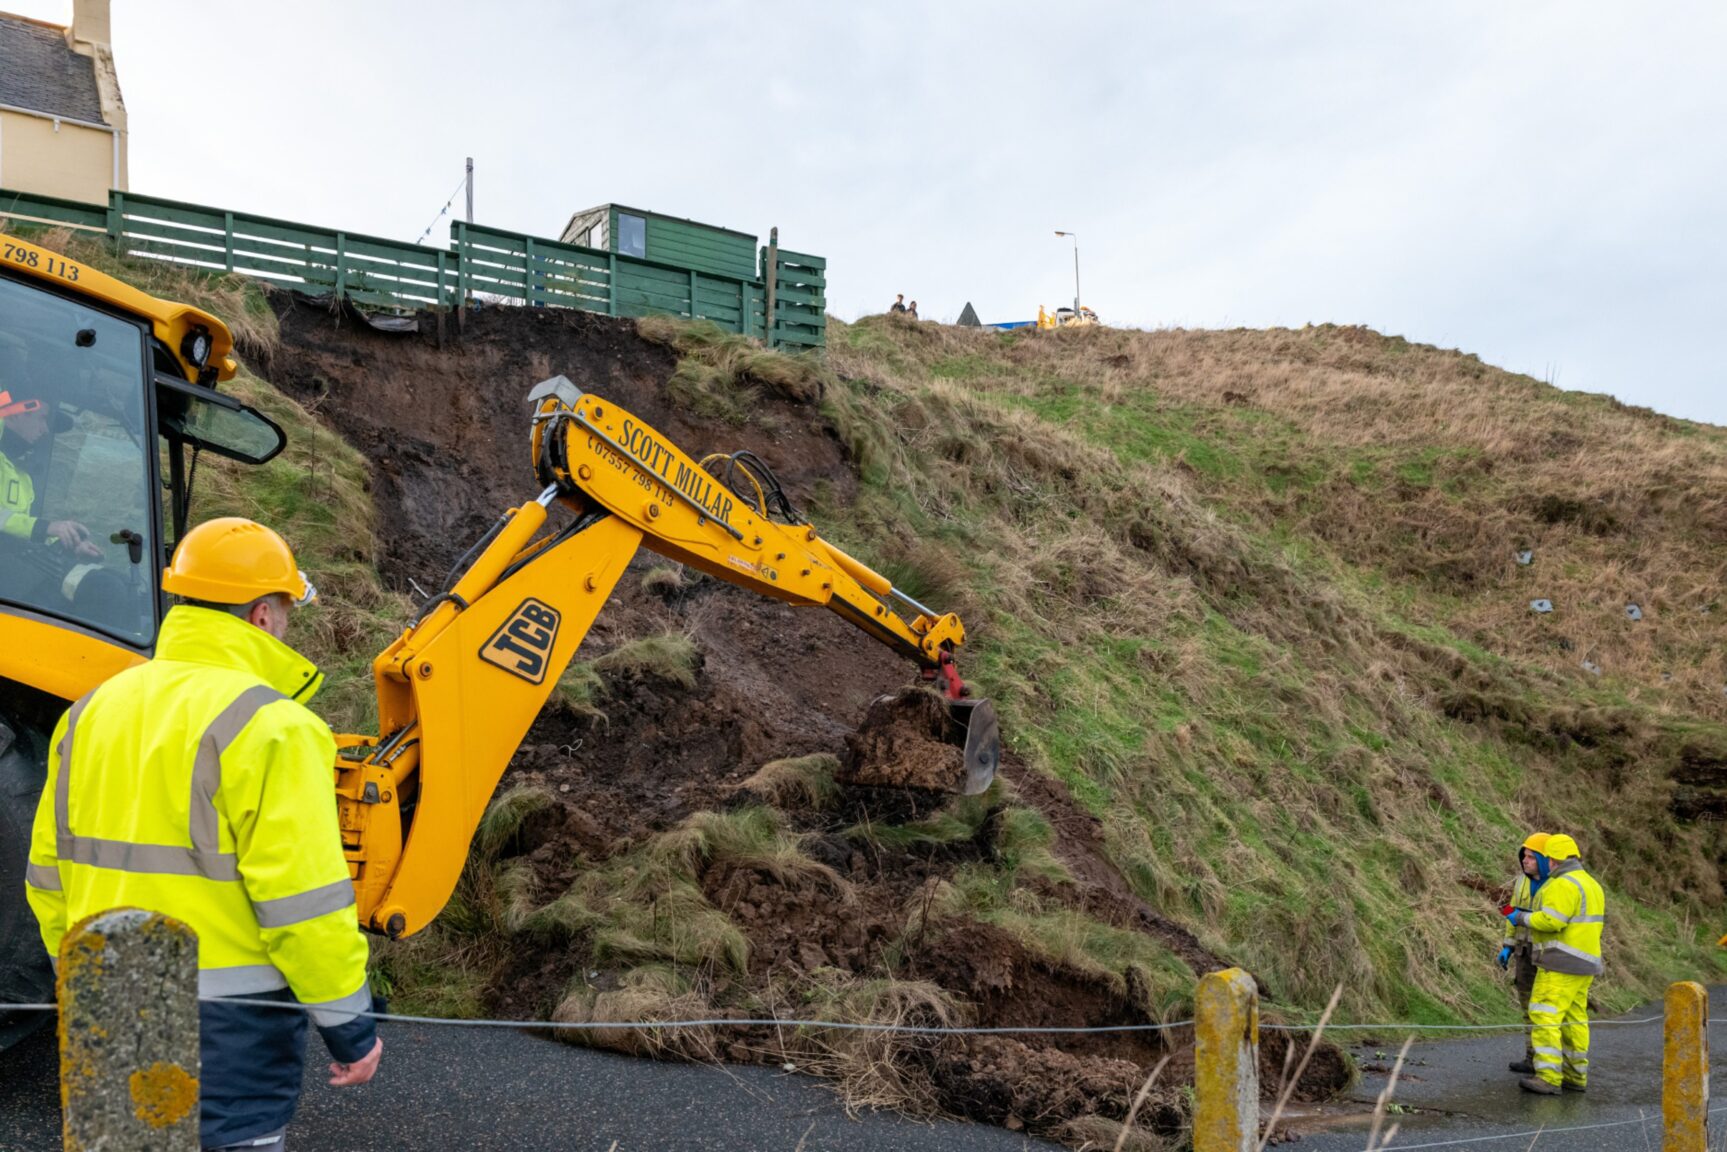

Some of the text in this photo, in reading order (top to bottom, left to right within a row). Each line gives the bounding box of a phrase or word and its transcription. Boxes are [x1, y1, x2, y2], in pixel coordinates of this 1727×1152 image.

[4, 243, 79, 281] 798 113
[595, 442, 675, 507] 07557 798 113
[618, 419, 733, 523] SCOTT MILLAR
[493, 604, 556, 676] JCB
